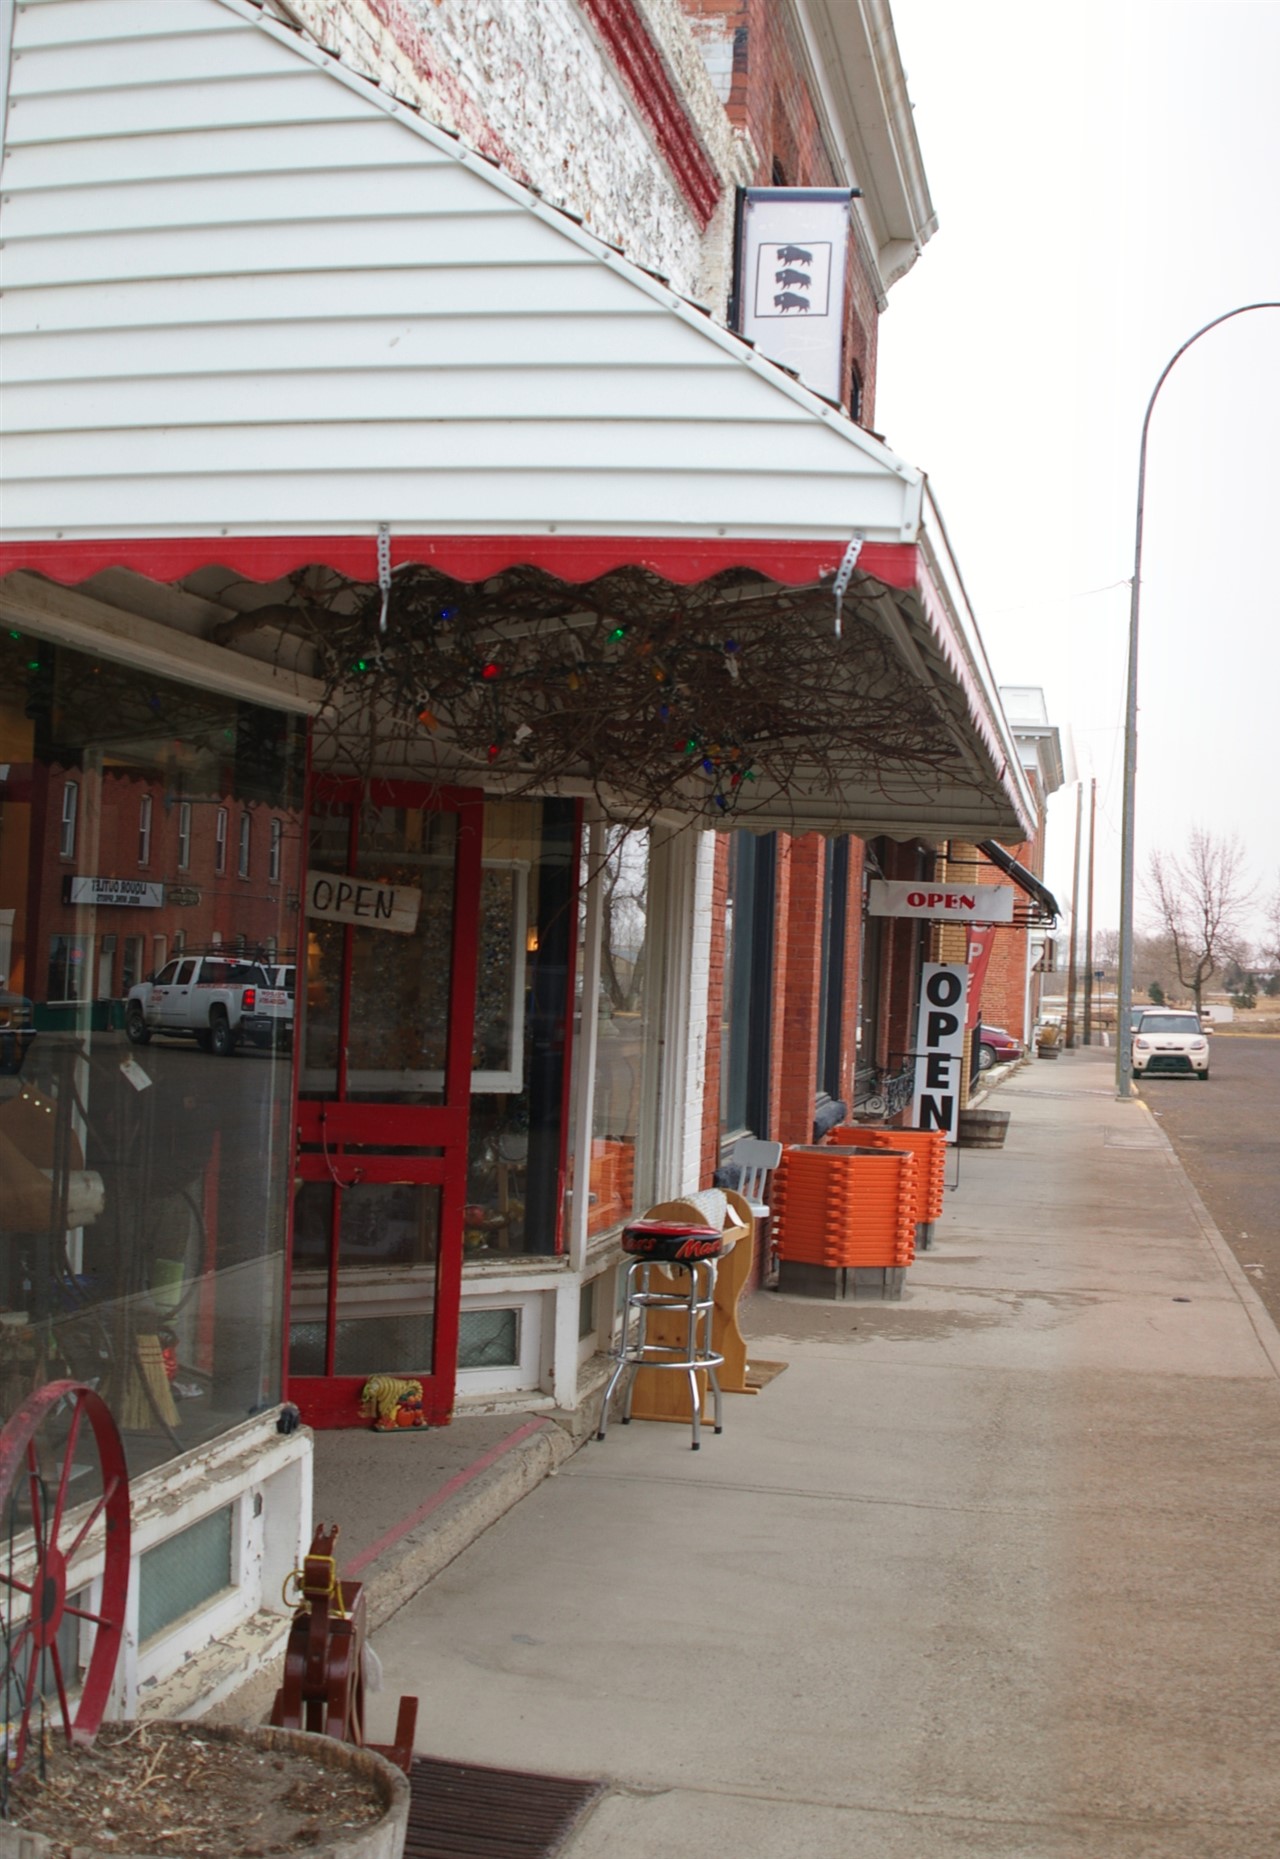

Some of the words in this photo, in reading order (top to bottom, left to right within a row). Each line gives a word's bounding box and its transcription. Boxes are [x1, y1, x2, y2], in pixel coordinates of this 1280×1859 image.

[313, 880, 394, 919] OPEN
[906, 891, 976, 911] OPEN
[919, 971, 962, 1132] OPEN
